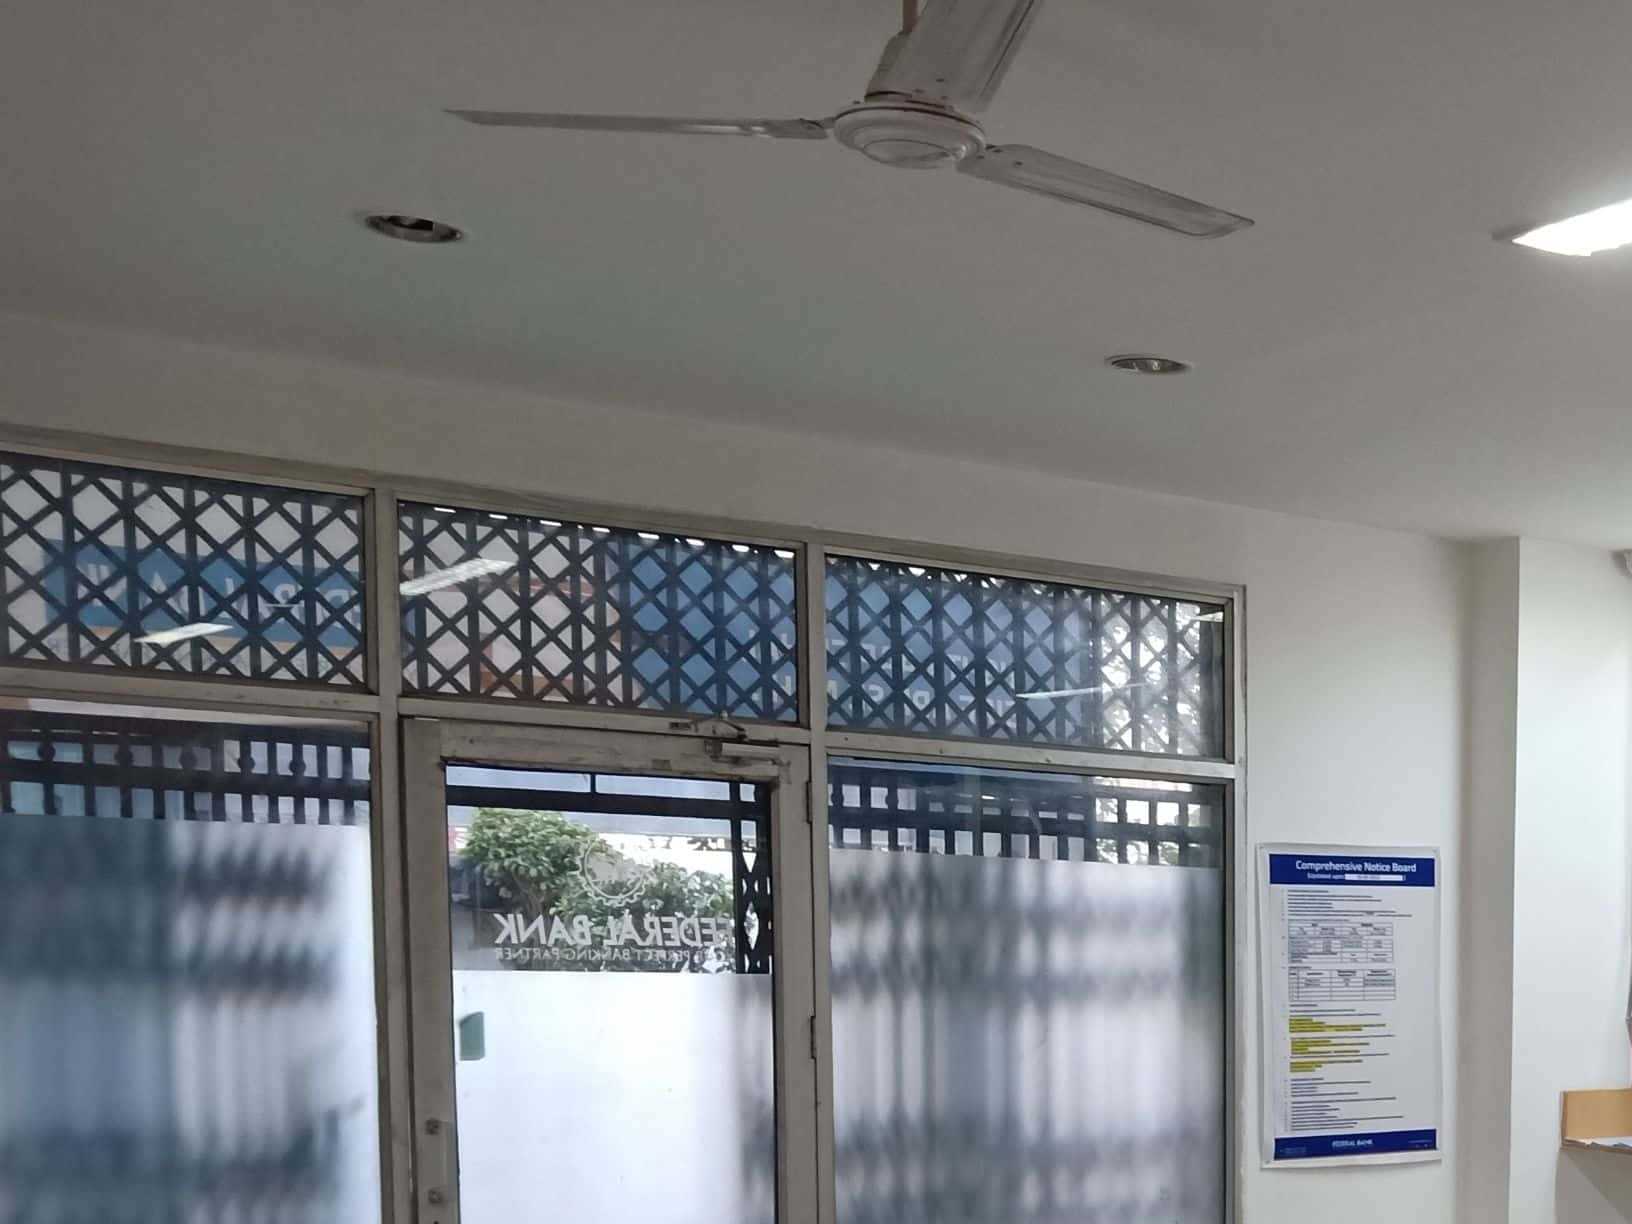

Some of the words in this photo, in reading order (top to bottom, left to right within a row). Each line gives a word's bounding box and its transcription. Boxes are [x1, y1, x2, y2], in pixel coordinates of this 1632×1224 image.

[1296, 860, 1362, 873] Comprehensive
[1364, 862, 1391, 872] Notice
[1392, 862, 1417, 873] Board
